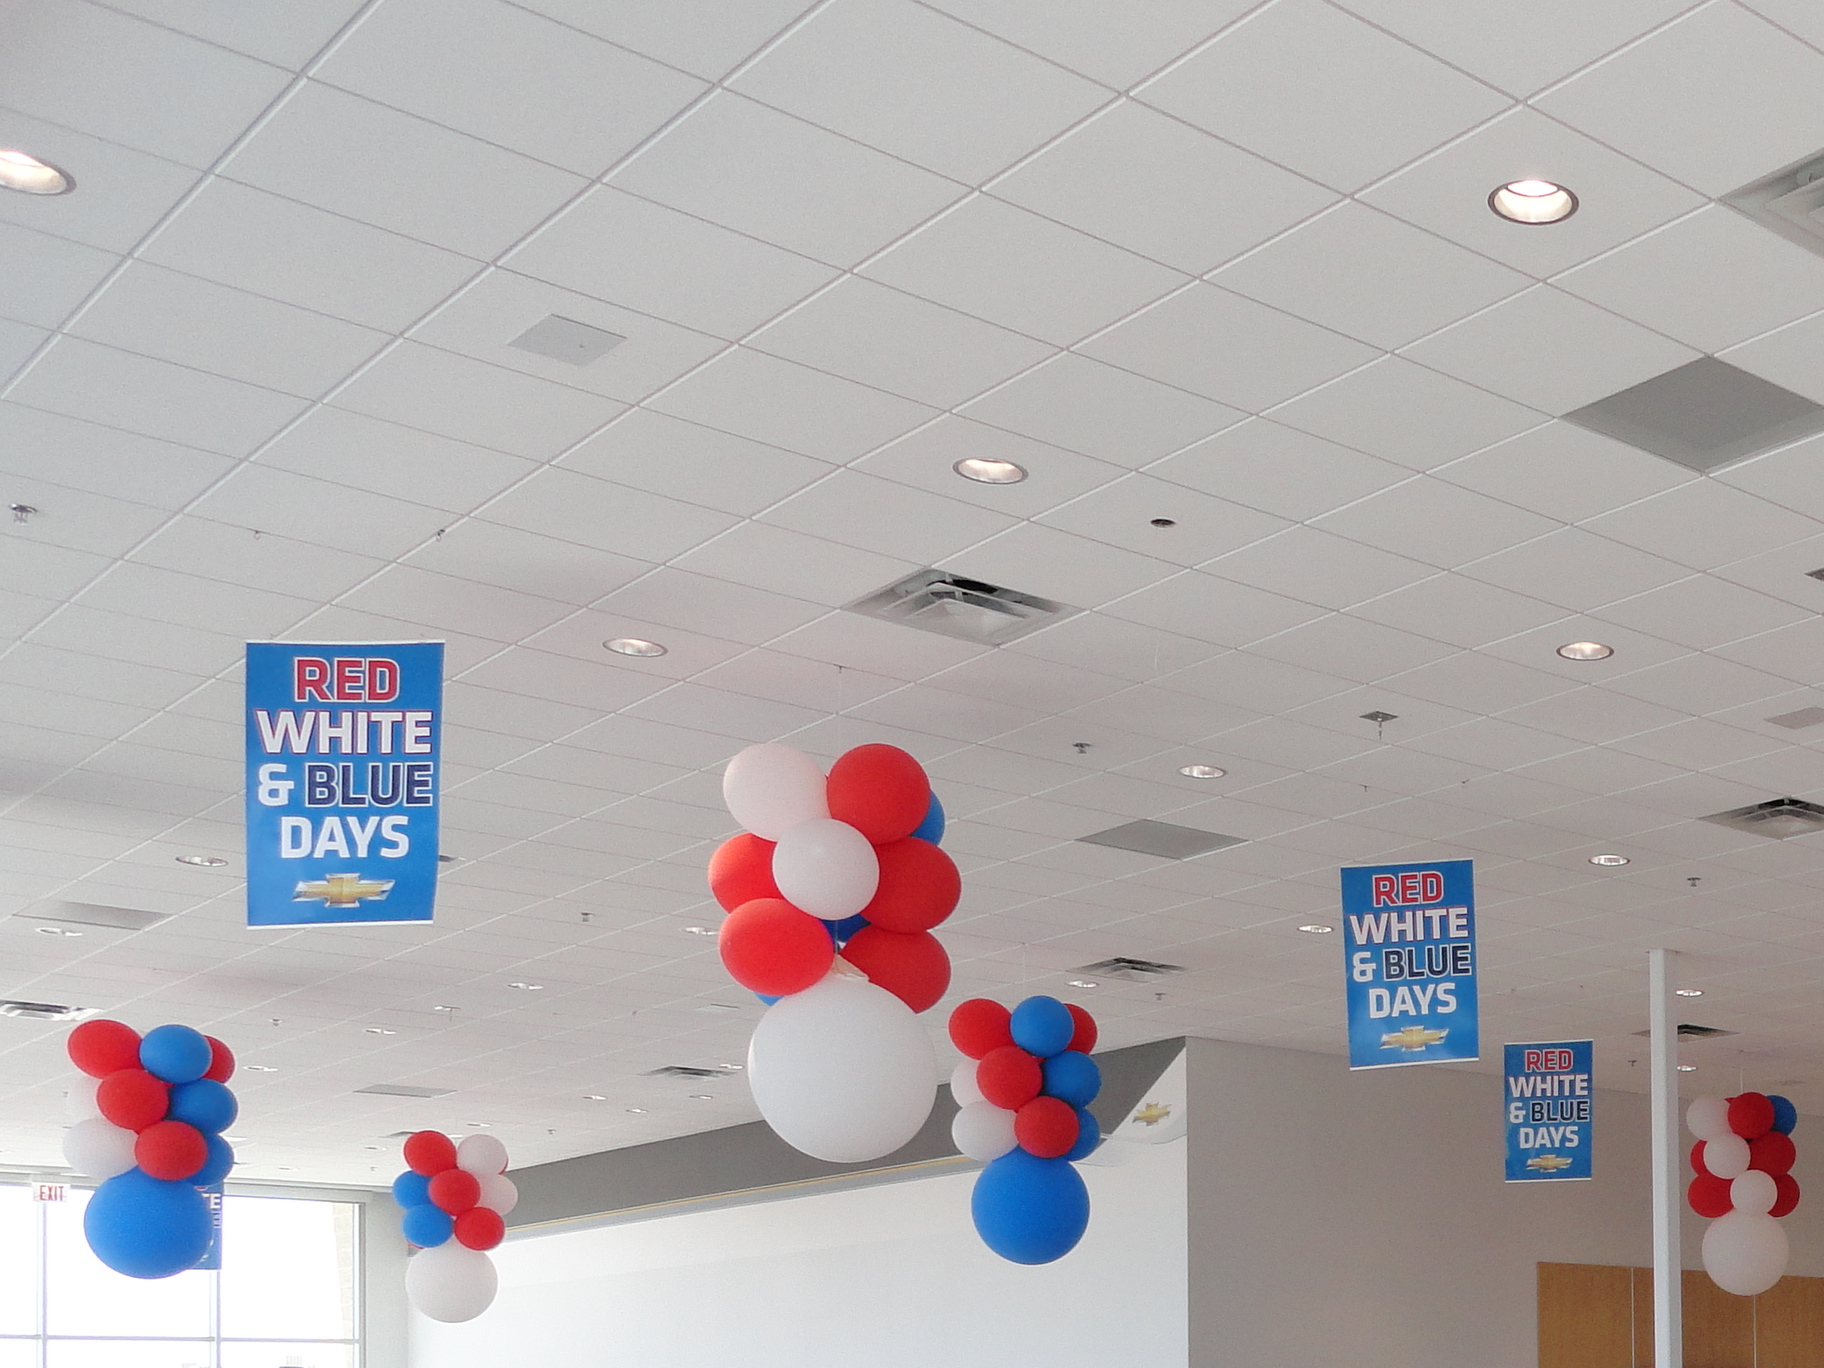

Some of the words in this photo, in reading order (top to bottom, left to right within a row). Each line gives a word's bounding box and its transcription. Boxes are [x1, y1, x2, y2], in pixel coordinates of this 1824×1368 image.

[294, 657, 400, 703] RED
[255, 710, 433, 754] WHITE
[258, 763, 295, 807] &
[305, 762, 433, 808] BLUE
[280, 815, 410, 859] DAYS
[1372, 871, 1444, 907] RED
[1349, 906, 1469, 945] WHITE
[1352, 951, 1376, 983] &
[1383, 943, 1472, 982] BLUE
[1368, 982, 1458, 1019] DAYS
[1525, 1049, 1574, 1072] RED
[1508, 1074, 1589, 1098] WHITE
[1509, 1102, 1526, 1124] &
[1530, 1099, 1590, 1124] BLUE
[1519, 1126, 1579, 1149] DAYS
[39, 1184, 65, 1201] EXIT
